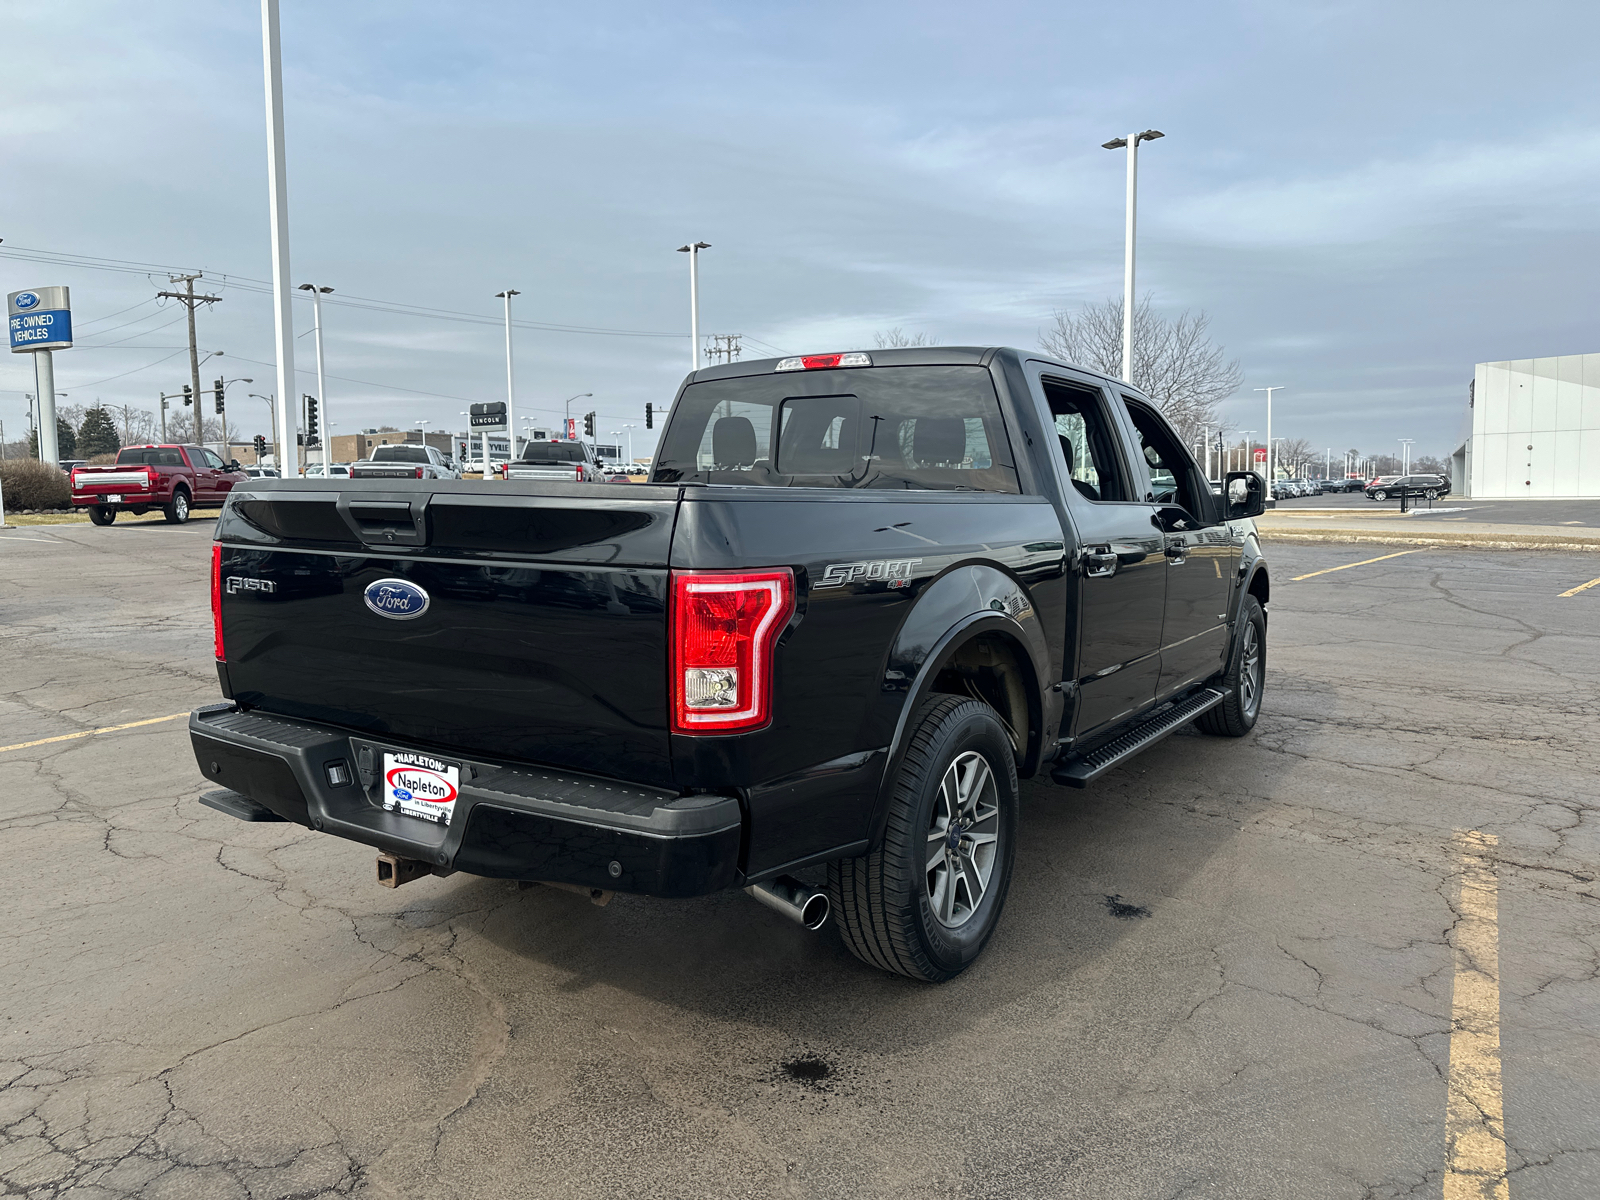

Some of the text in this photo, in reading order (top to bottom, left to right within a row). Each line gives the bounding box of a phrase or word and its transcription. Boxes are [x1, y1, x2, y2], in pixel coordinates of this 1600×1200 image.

[17, 294, 32, 306] Ford
[10, 314, 54, 330] PRE-OWNED
[14, 328, 49, 342] VEHICLES
[470, 442, 509, 451] LIBEYVILLE
[812, 558, 923, 590] SPORT
[376, 586, 411, 611] Ford
[397, 753, 442, 771] NAPLETON
[398, 772, 445, 797] Napleton
[396, 790, 410, 800] Ford
[400, 807, 439, 822] LIBERTYVILLE
[421, 801, 452, 813] Libertyville
